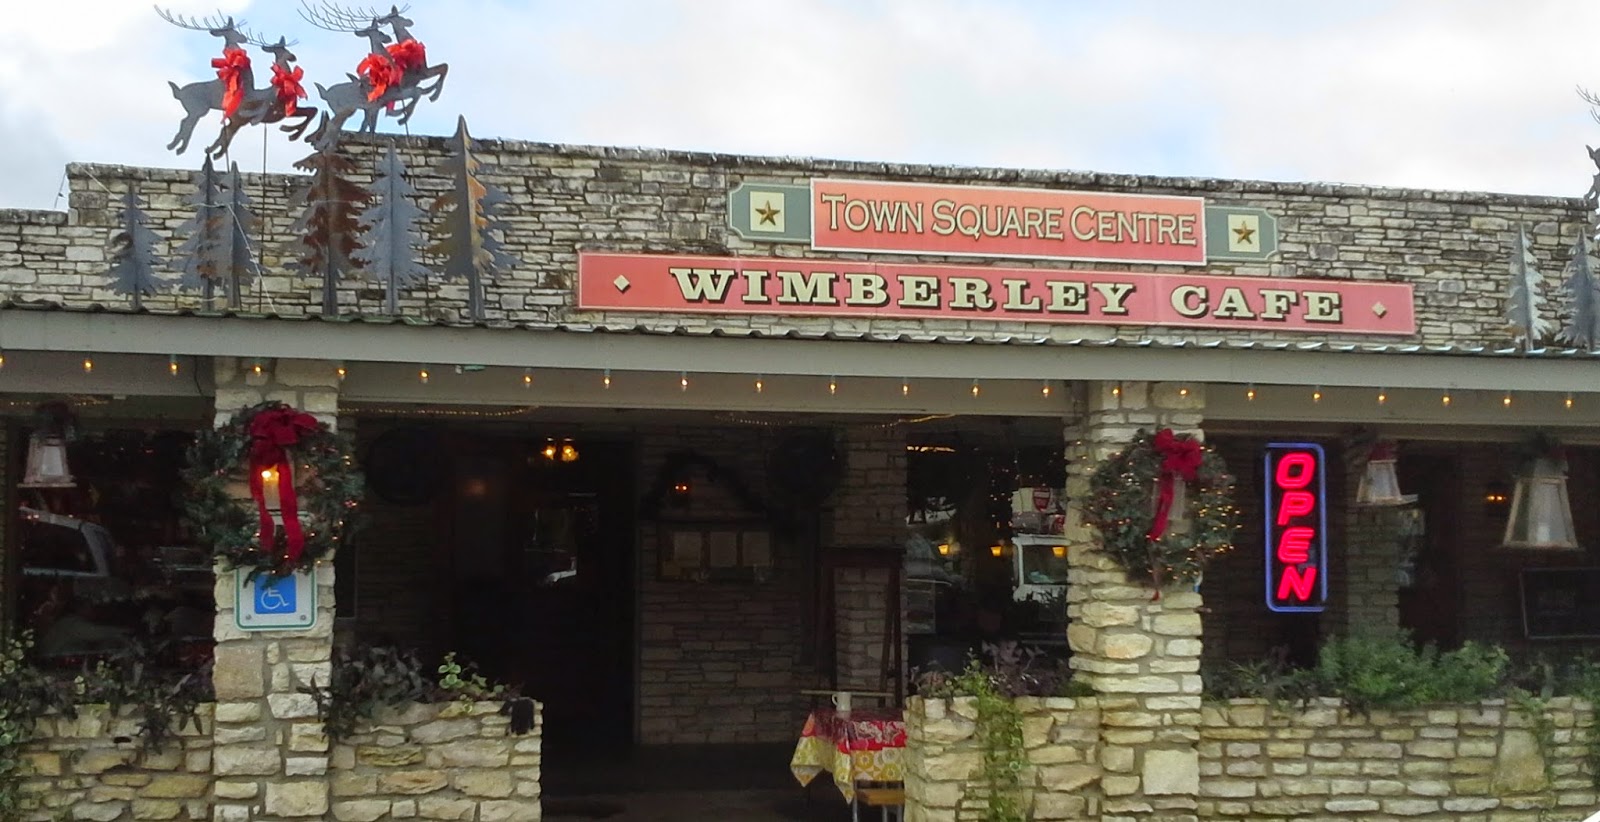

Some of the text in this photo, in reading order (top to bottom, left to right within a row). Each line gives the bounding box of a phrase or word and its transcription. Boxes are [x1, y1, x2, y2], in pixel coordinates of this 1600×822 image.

[822, 193, 1197, 246] TOWN SQUARE CENTRE
[670, 267, 1343, 324] WIMBERLEY CAFE
[1275, 452, 1318, 601] OPEN
